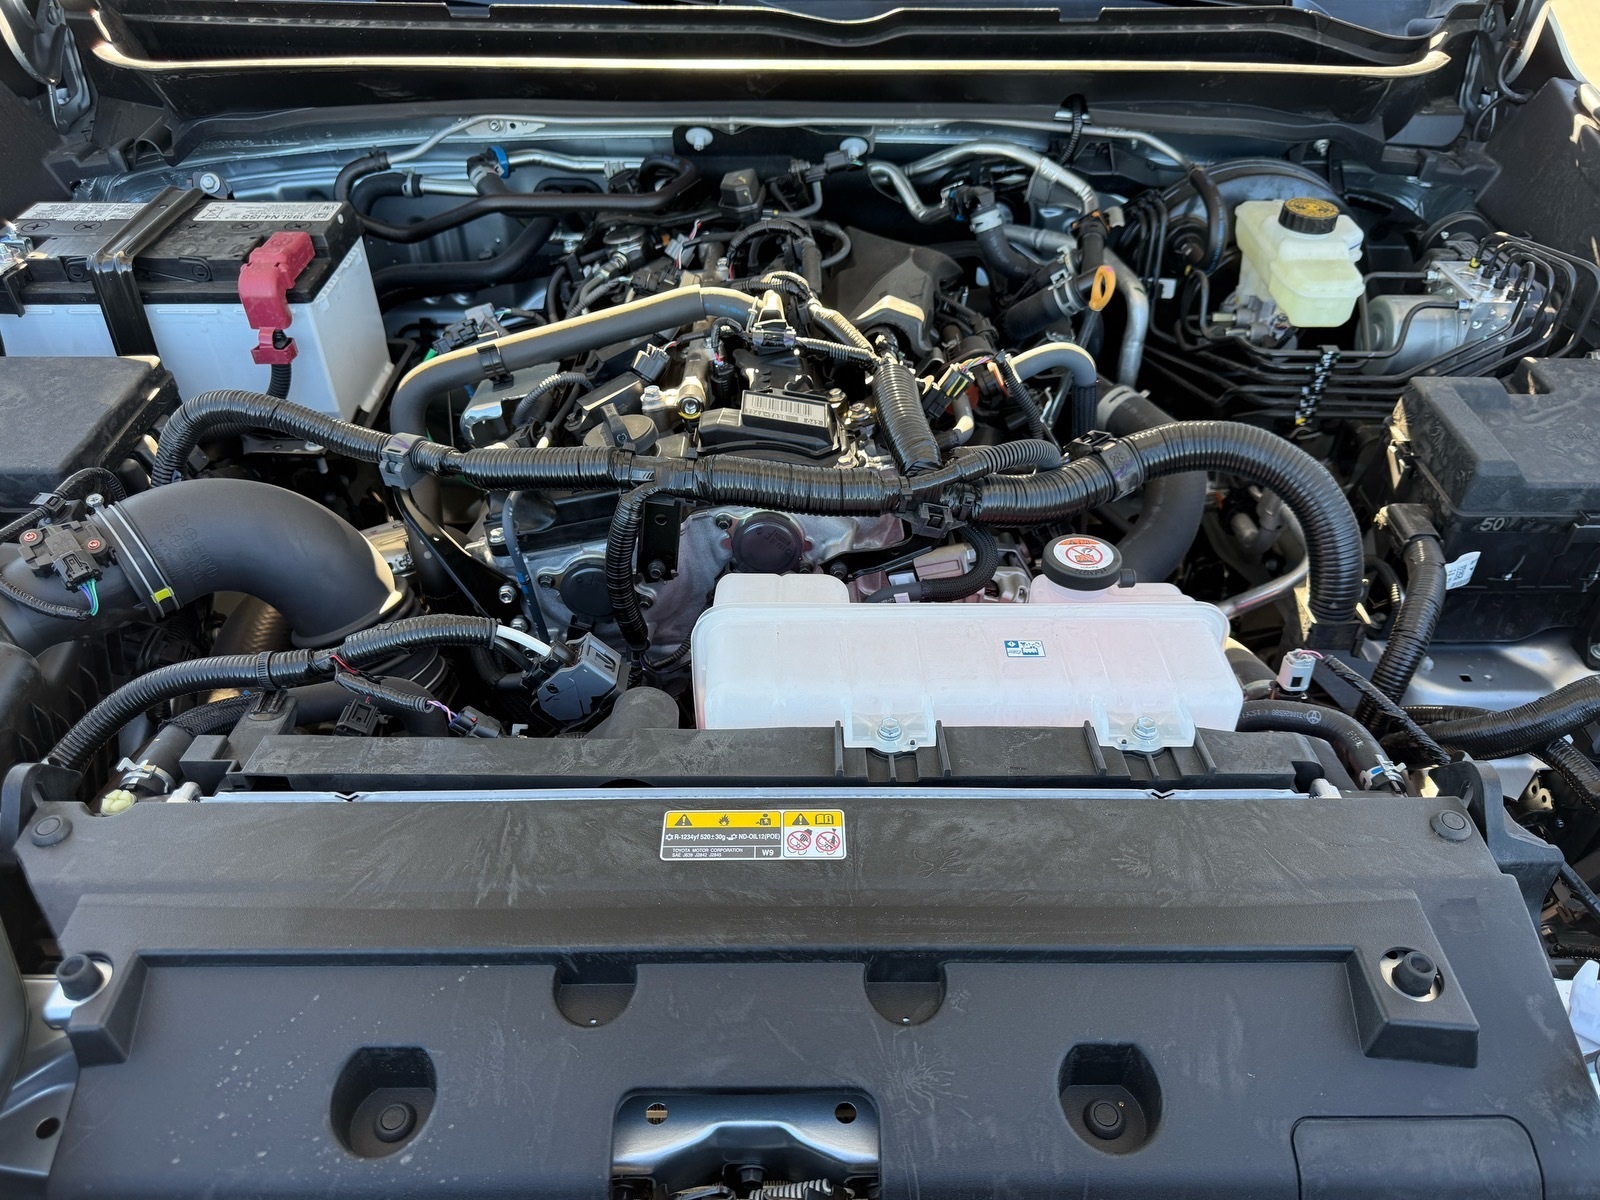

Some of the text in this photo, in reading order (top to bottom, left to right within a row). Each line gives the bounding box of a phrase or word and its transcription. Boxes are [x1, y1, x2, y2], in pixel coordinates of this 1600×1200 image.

[1479, 517, 1506, 532] 50
[674, 833, 781, 842] R-1234yf 520±30g ND-OIL12(POE)
[761, 849, 775, 857] W9
